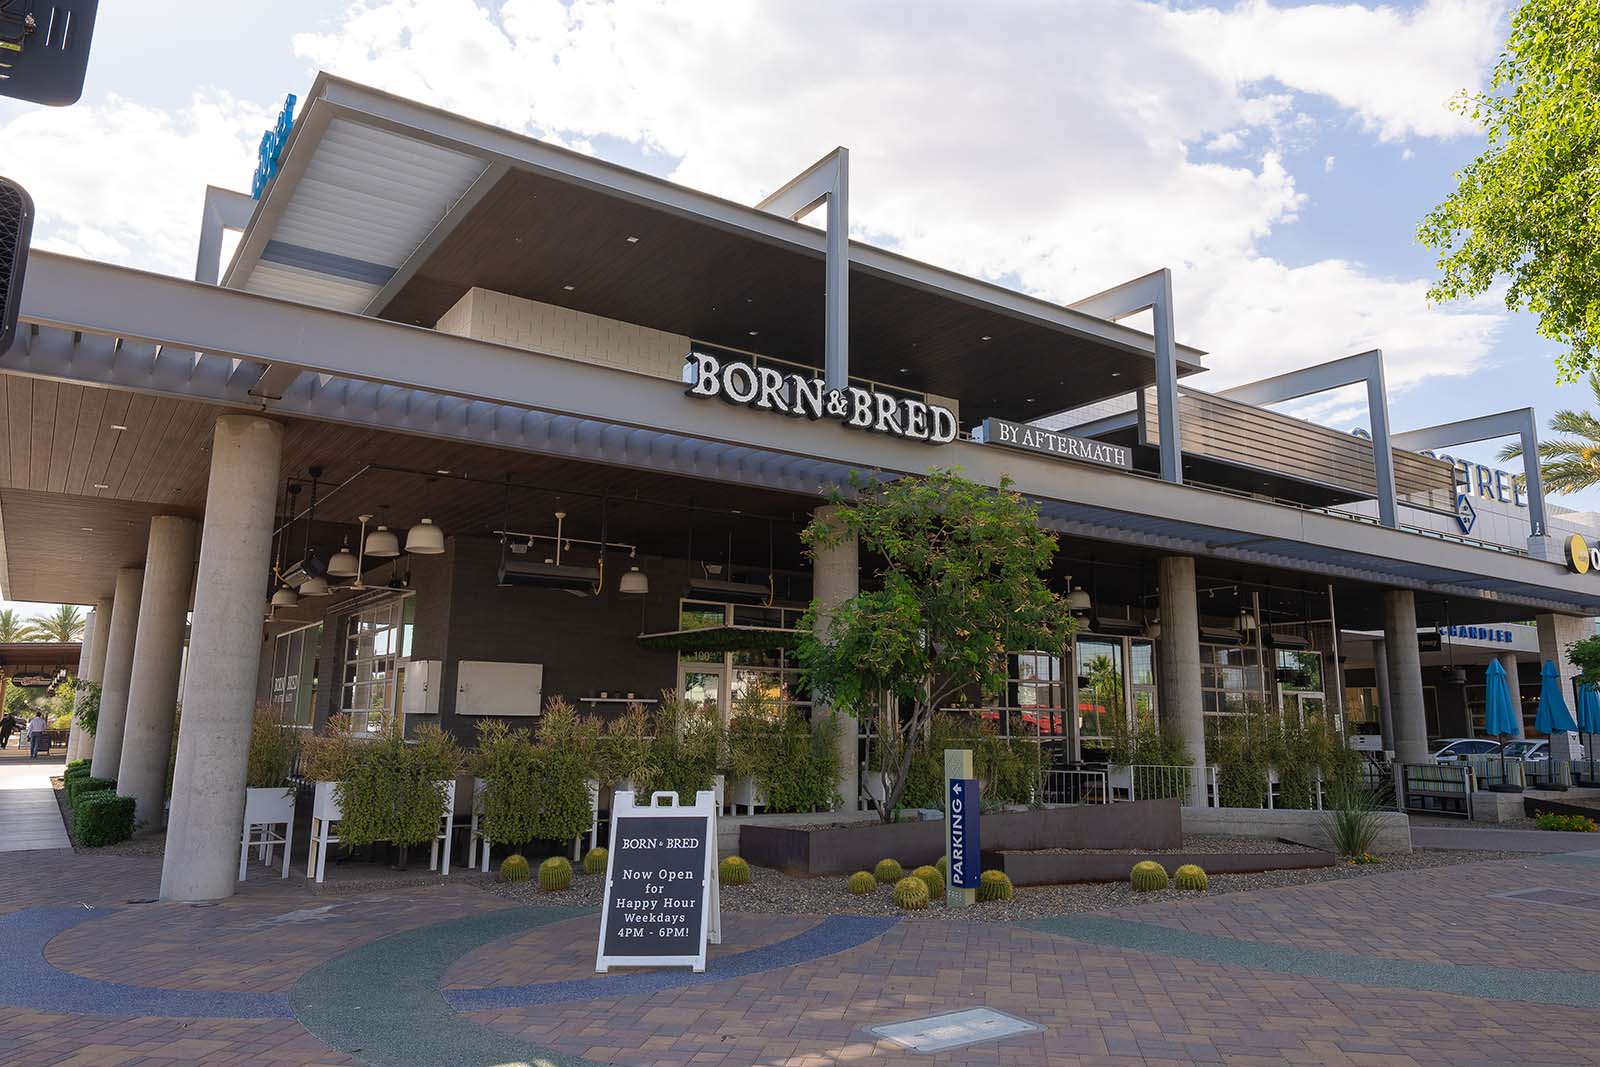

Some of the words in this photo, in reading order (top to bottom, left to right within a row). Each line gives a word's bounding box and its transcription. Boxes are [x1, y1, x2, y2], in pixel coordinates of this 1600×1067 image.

[691, 351, 826, 418] BORN
[849, 386, 957, 443] BRED
[999, 422, 1019, 444] BY
[1022, 429, 1126, 466] AFTERMATH
[1440, 625, 1513, 643] CHANDLER
[622, 838, 658, 849] BORN
[666, 838, 699, 849] BRED
[951, 798, 963, 885] PARKING
[622, 869, 653, 880] Now
[658, 869, 693, 882] Open
[644, 883, 665, 894] for
[616, 898, 658, 910] Happy
[663, 898, 696, 908] Hour
[624, 912, 686, 925] Weekdays
[617, 927, 644, 938] 4PM
[658, 927, 689, 938] 6PM!
